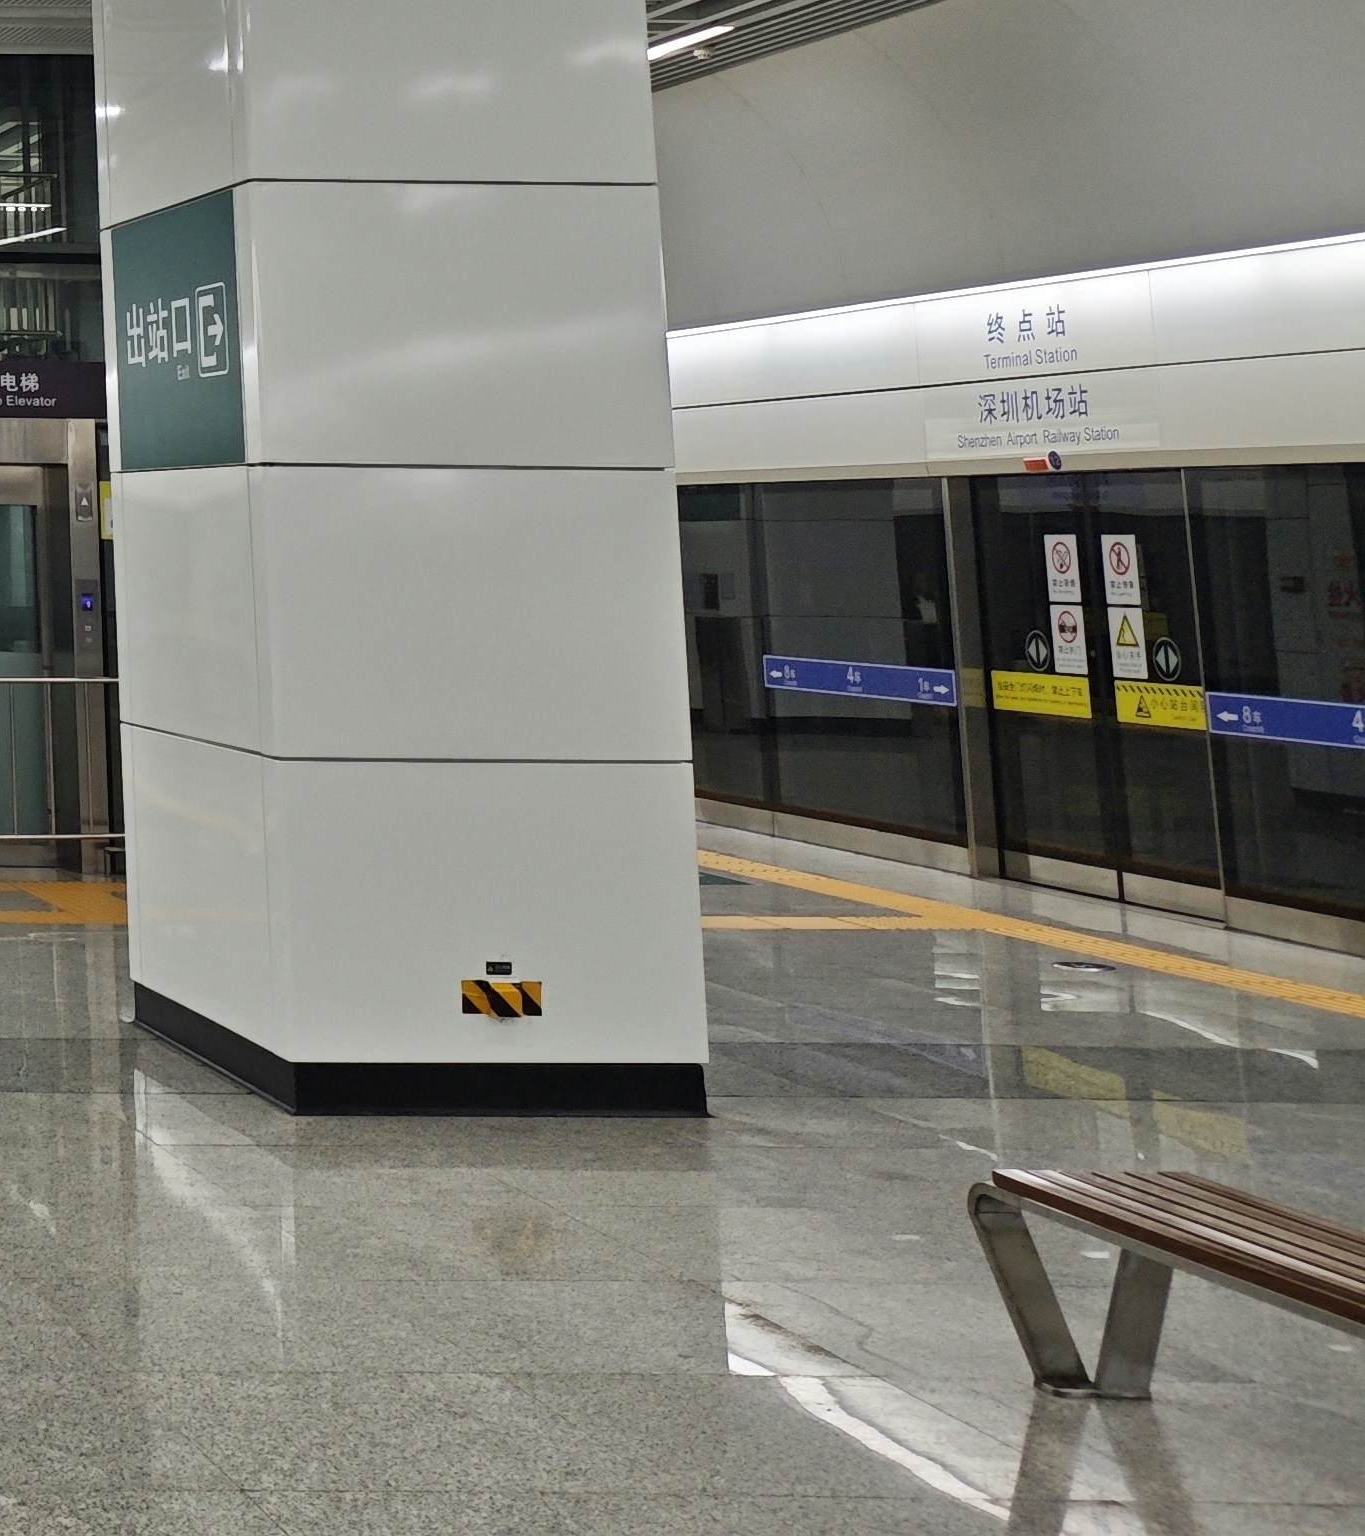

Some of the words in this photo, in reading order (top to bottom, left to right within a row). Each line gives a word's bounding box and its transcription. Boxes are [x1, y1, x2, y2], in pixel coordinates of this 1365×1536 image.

[126, 298, 192, 368] 出站口
[986, 304, 1066, 344] 终点站
[984, 349, 1033, 370] Terminal
[1035, 348, 1078, 365] Station
[6, 395, 57, 408] Elevator
[978, 384, 1089, 426] 深圳机场站
[957, 434, 1002, 449] Shenzhen
[1007, 431, 1038, 448] Airport
[1043, 429, 1082, 446] Railway
[1084, 425, 1120, 442] Station
